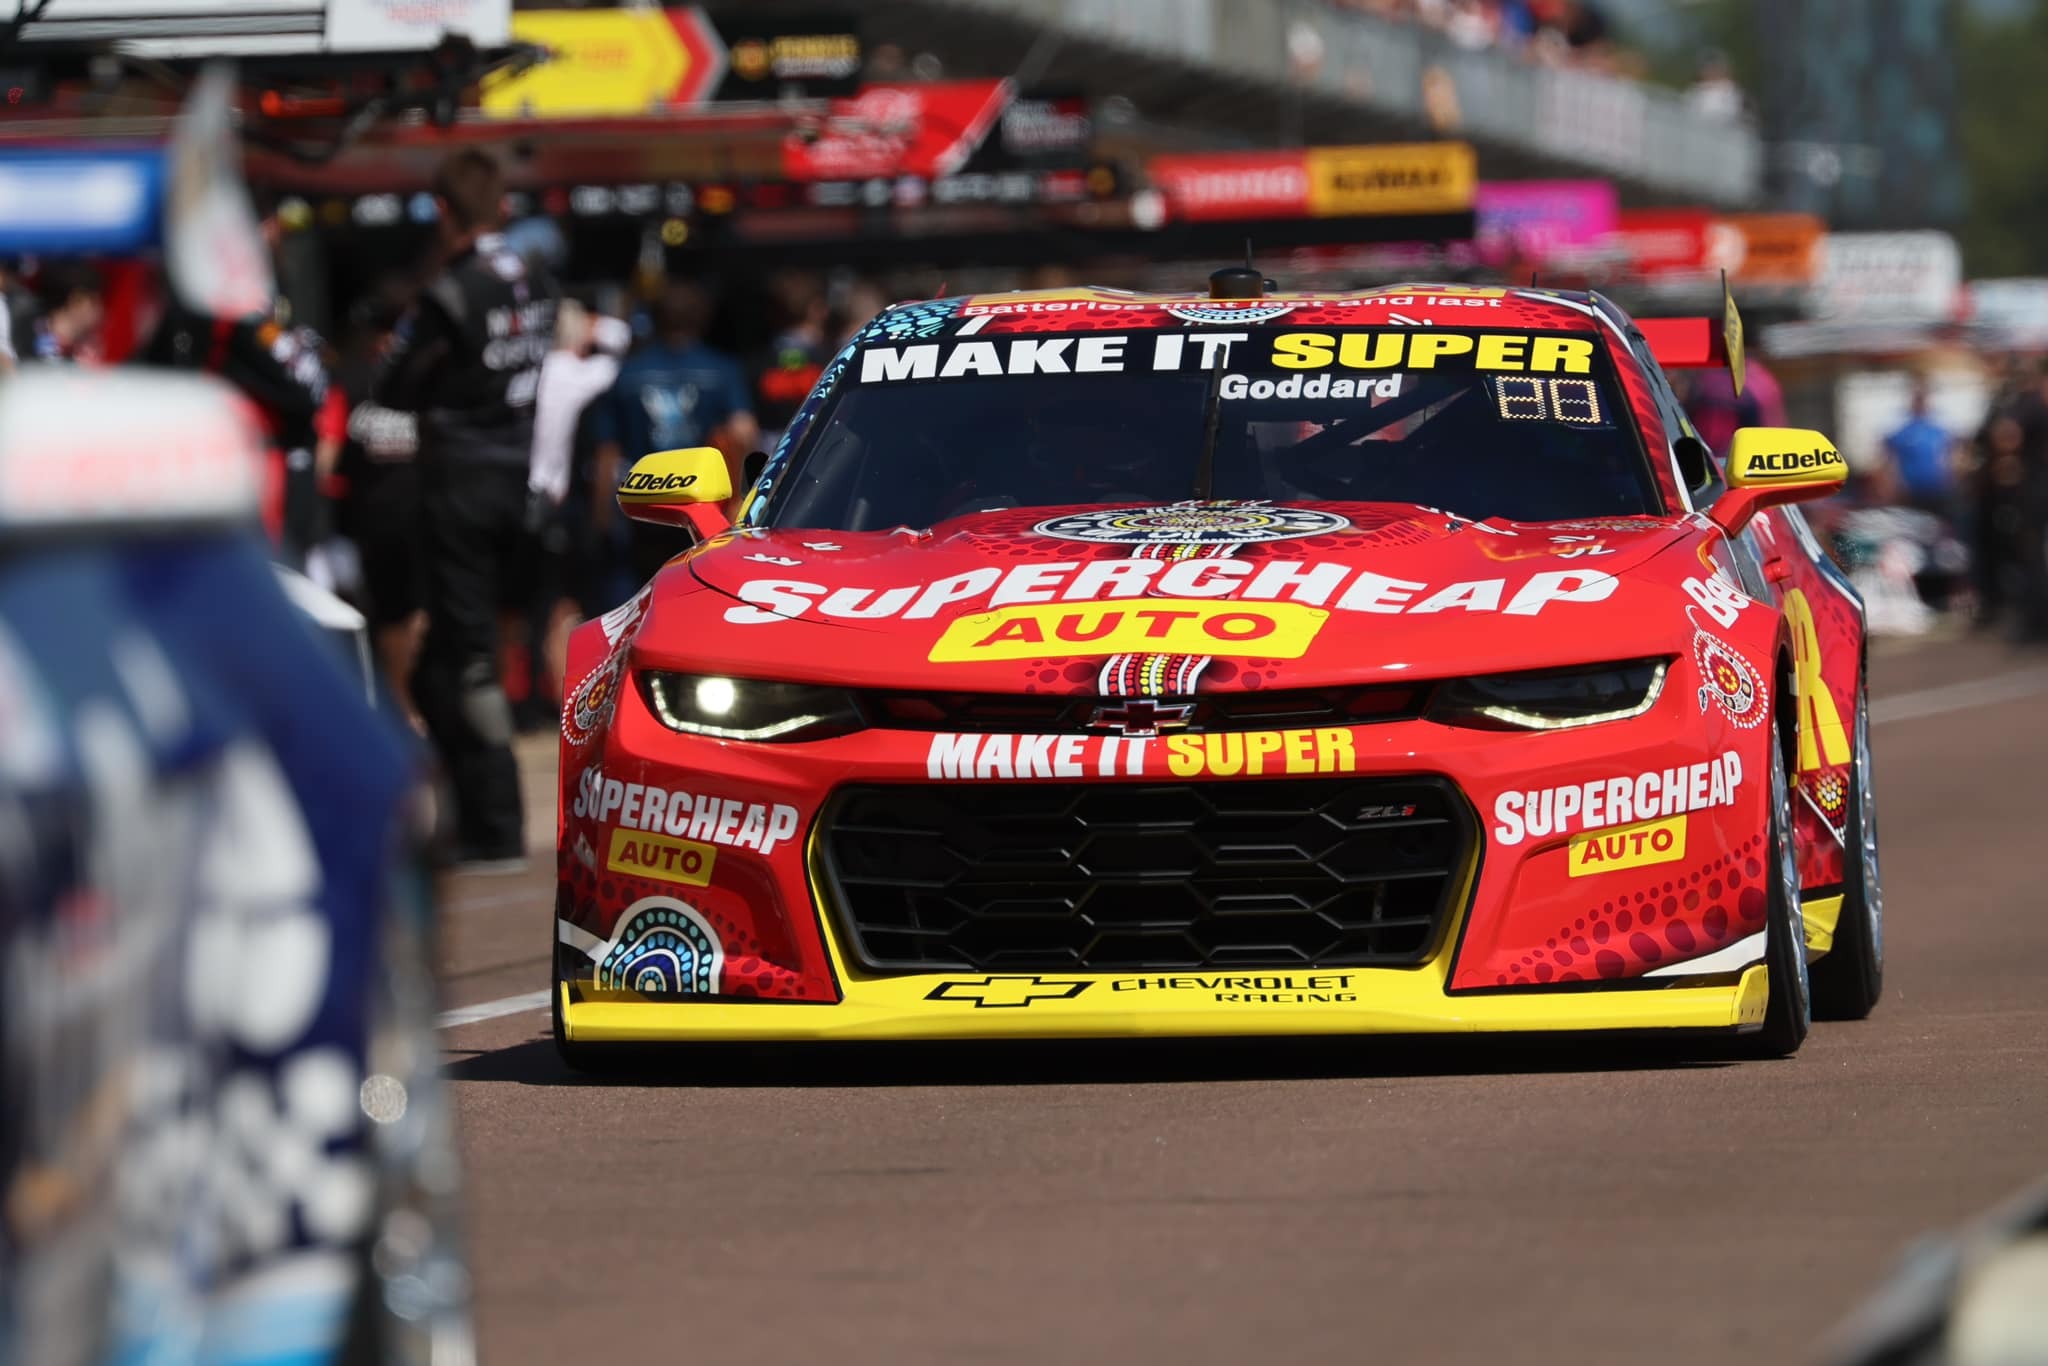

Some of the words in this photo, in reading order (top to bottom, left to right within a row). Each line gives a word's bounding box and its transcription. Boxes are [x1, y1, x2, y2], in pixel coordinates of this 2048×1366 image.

[964, 301, 1146, 317] Batteries
[1338, 296, 1414, 309] and
[1427, 295, 1504, 309] last
[860, 336, 1128, 384] MAKE
[1152, 333, 1248, 370] IT
[1271, 333, 1594, 374] SUPER
[1219, 374, 1403, 400] Goddard
[723, 558, 1620, 626] SUPERCHEAP
[970, 610, 1277, 649] AUTO
[926, 733, 1090, 780] MAKE
[1098, 735, 1158, 777] IT
[1167, 727, 1356, 777] SUPER
[573, 765, 799, 856] SUPERCHEAP
[1494, 749, 1743, 846] SUPERCHEAP
[617, 840, 704, 876] AUTO
[1580, 827, 1674, 865] AUTO
[1111, 974, 1357, 992] CHEVROLET
[1215, 992, 1358, 1004] RACING
